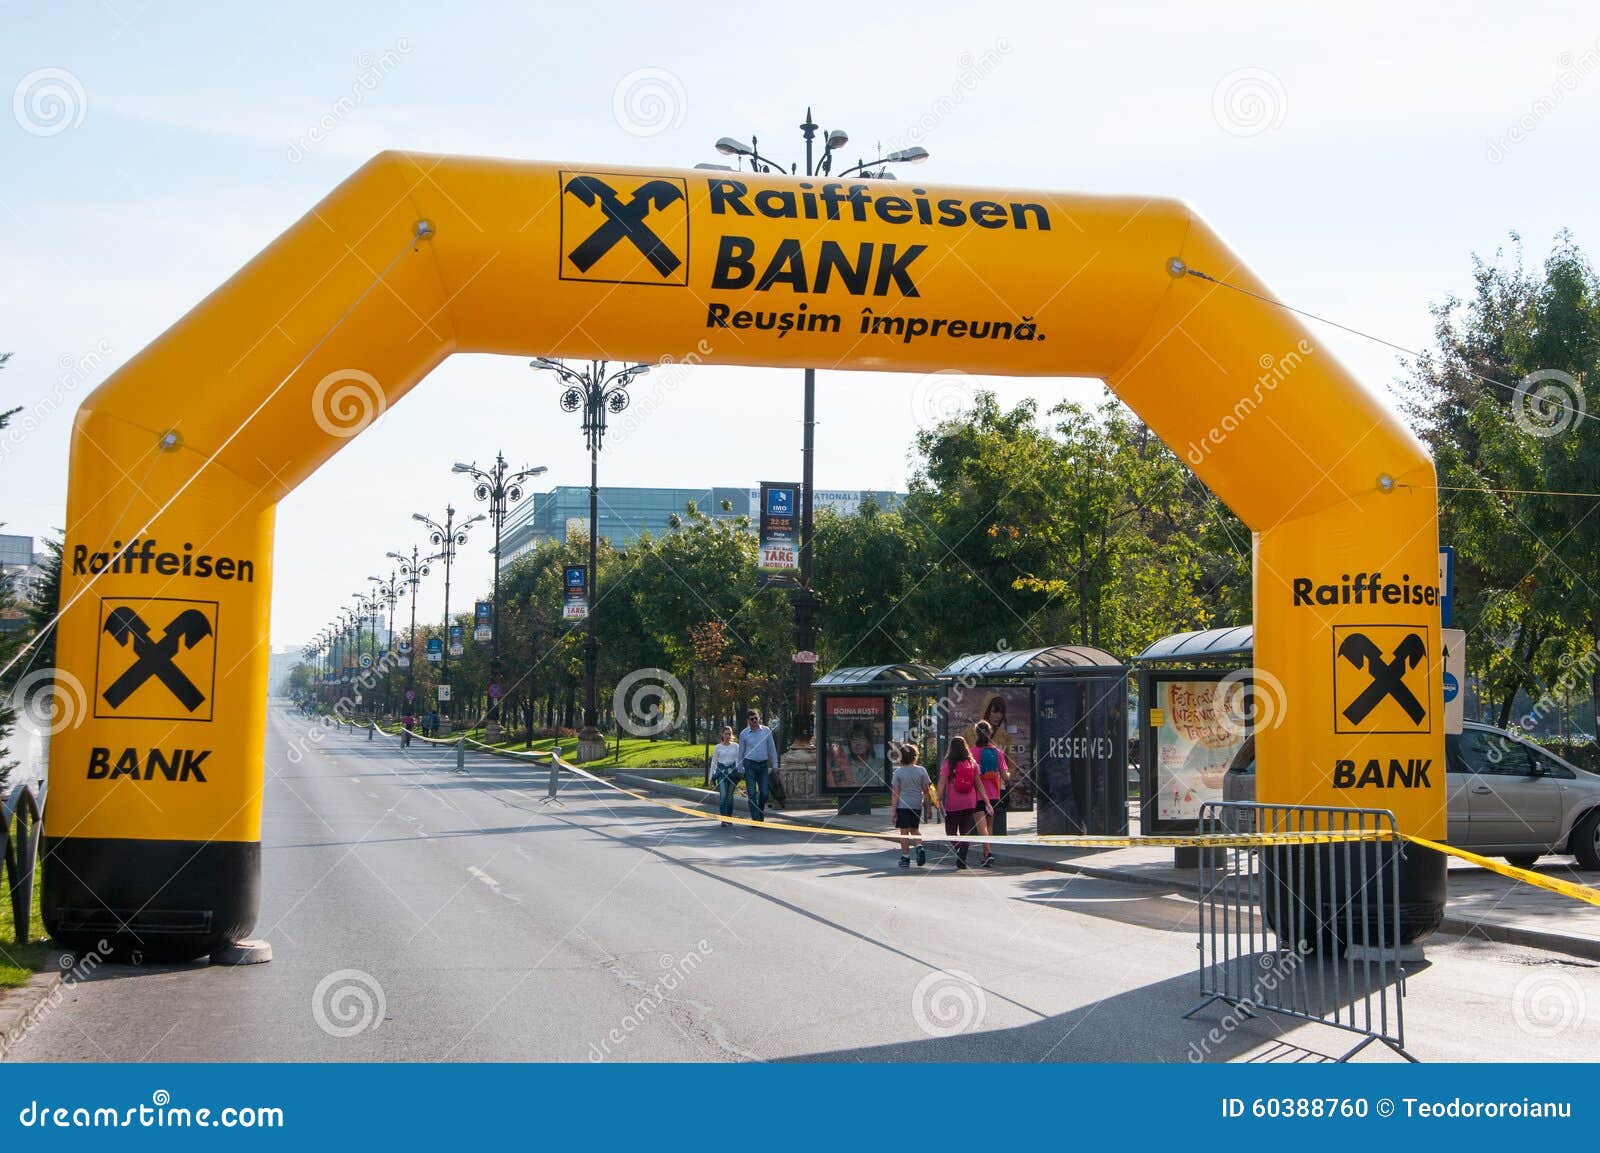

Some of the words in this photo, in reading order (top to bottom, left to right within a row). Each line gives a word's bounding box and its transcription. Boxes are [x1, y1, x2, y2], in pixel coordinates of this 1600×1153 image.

[707, 178, 1052, 231] Raiffeisen
[711, 235, 928, 298] BANK
[706, 302, 842, 339] Reușim
[860, 308, 1047, 344] împreună.
[72, 538, 254, 583] Raiffeisen
[86, 747, 213, 783] BANK
[1050, 736, 1113, 760] RESERVED
[1332, 759, 1433, 789] BANK
